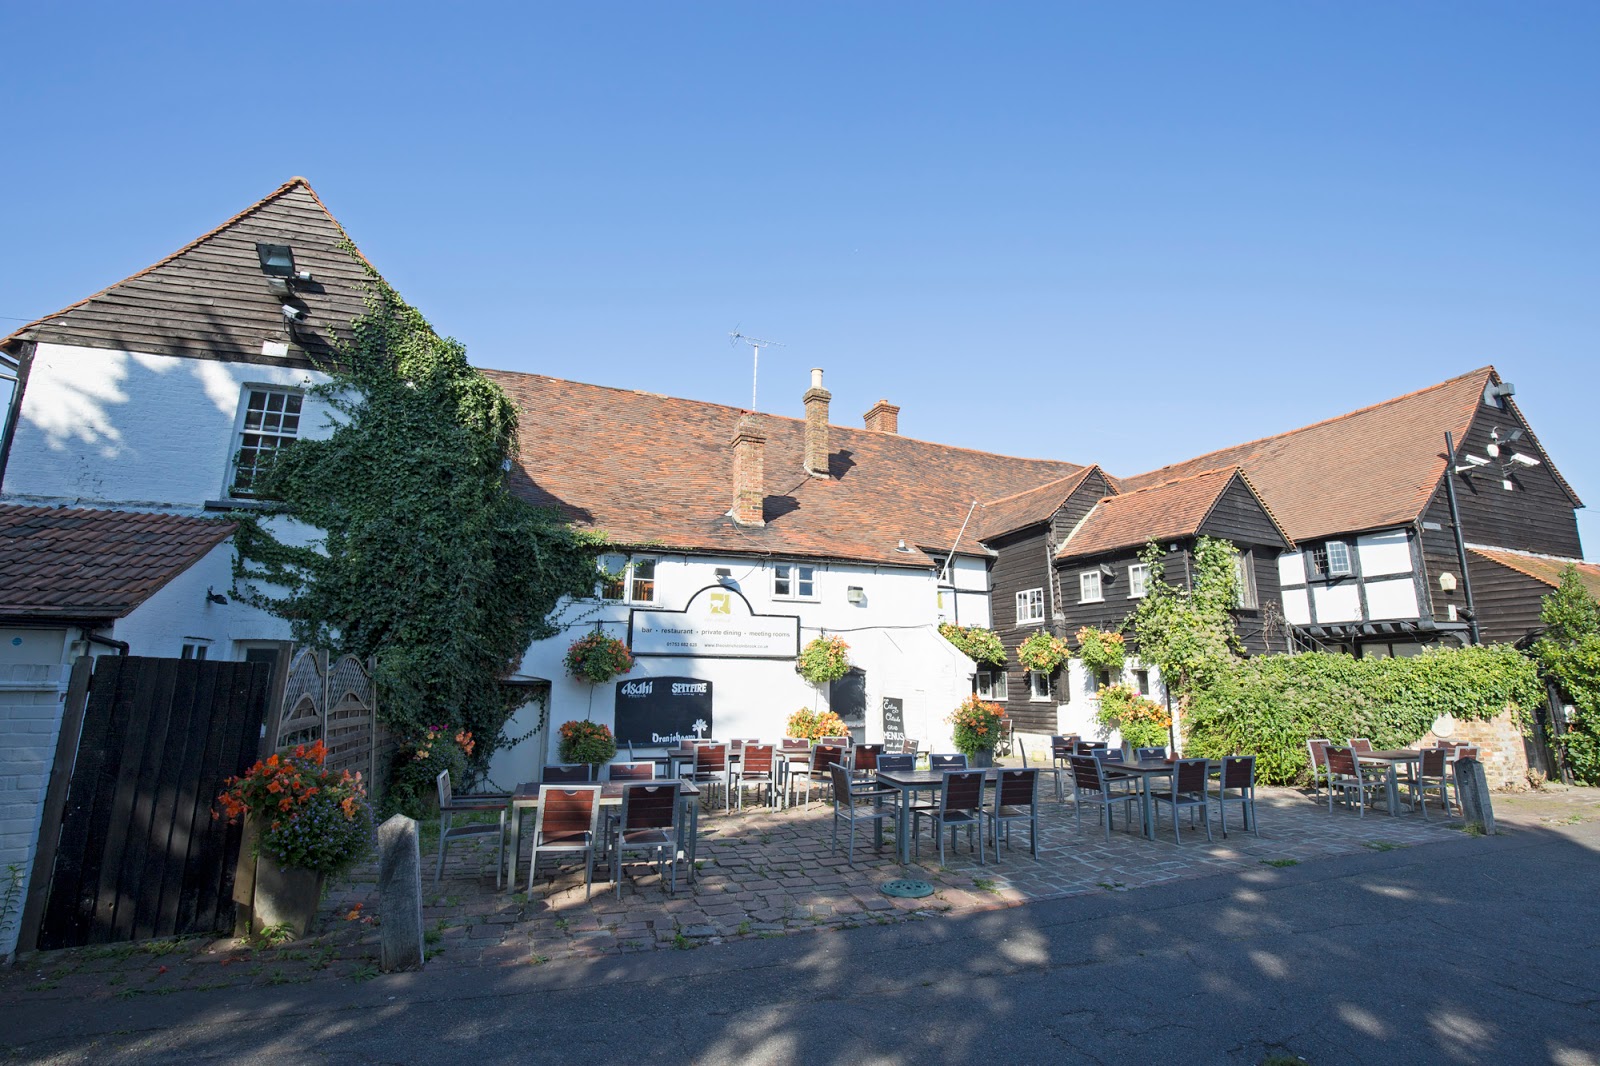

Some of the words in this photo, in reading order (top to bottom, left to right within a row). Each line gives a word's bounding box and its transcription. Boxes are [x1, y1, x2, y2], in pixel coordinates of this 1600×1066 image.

[621, 681, 653, 695] Asahi
[671, 683, 707, 693] SPITFIRE
[884, 731, 904, 740] MENUS
